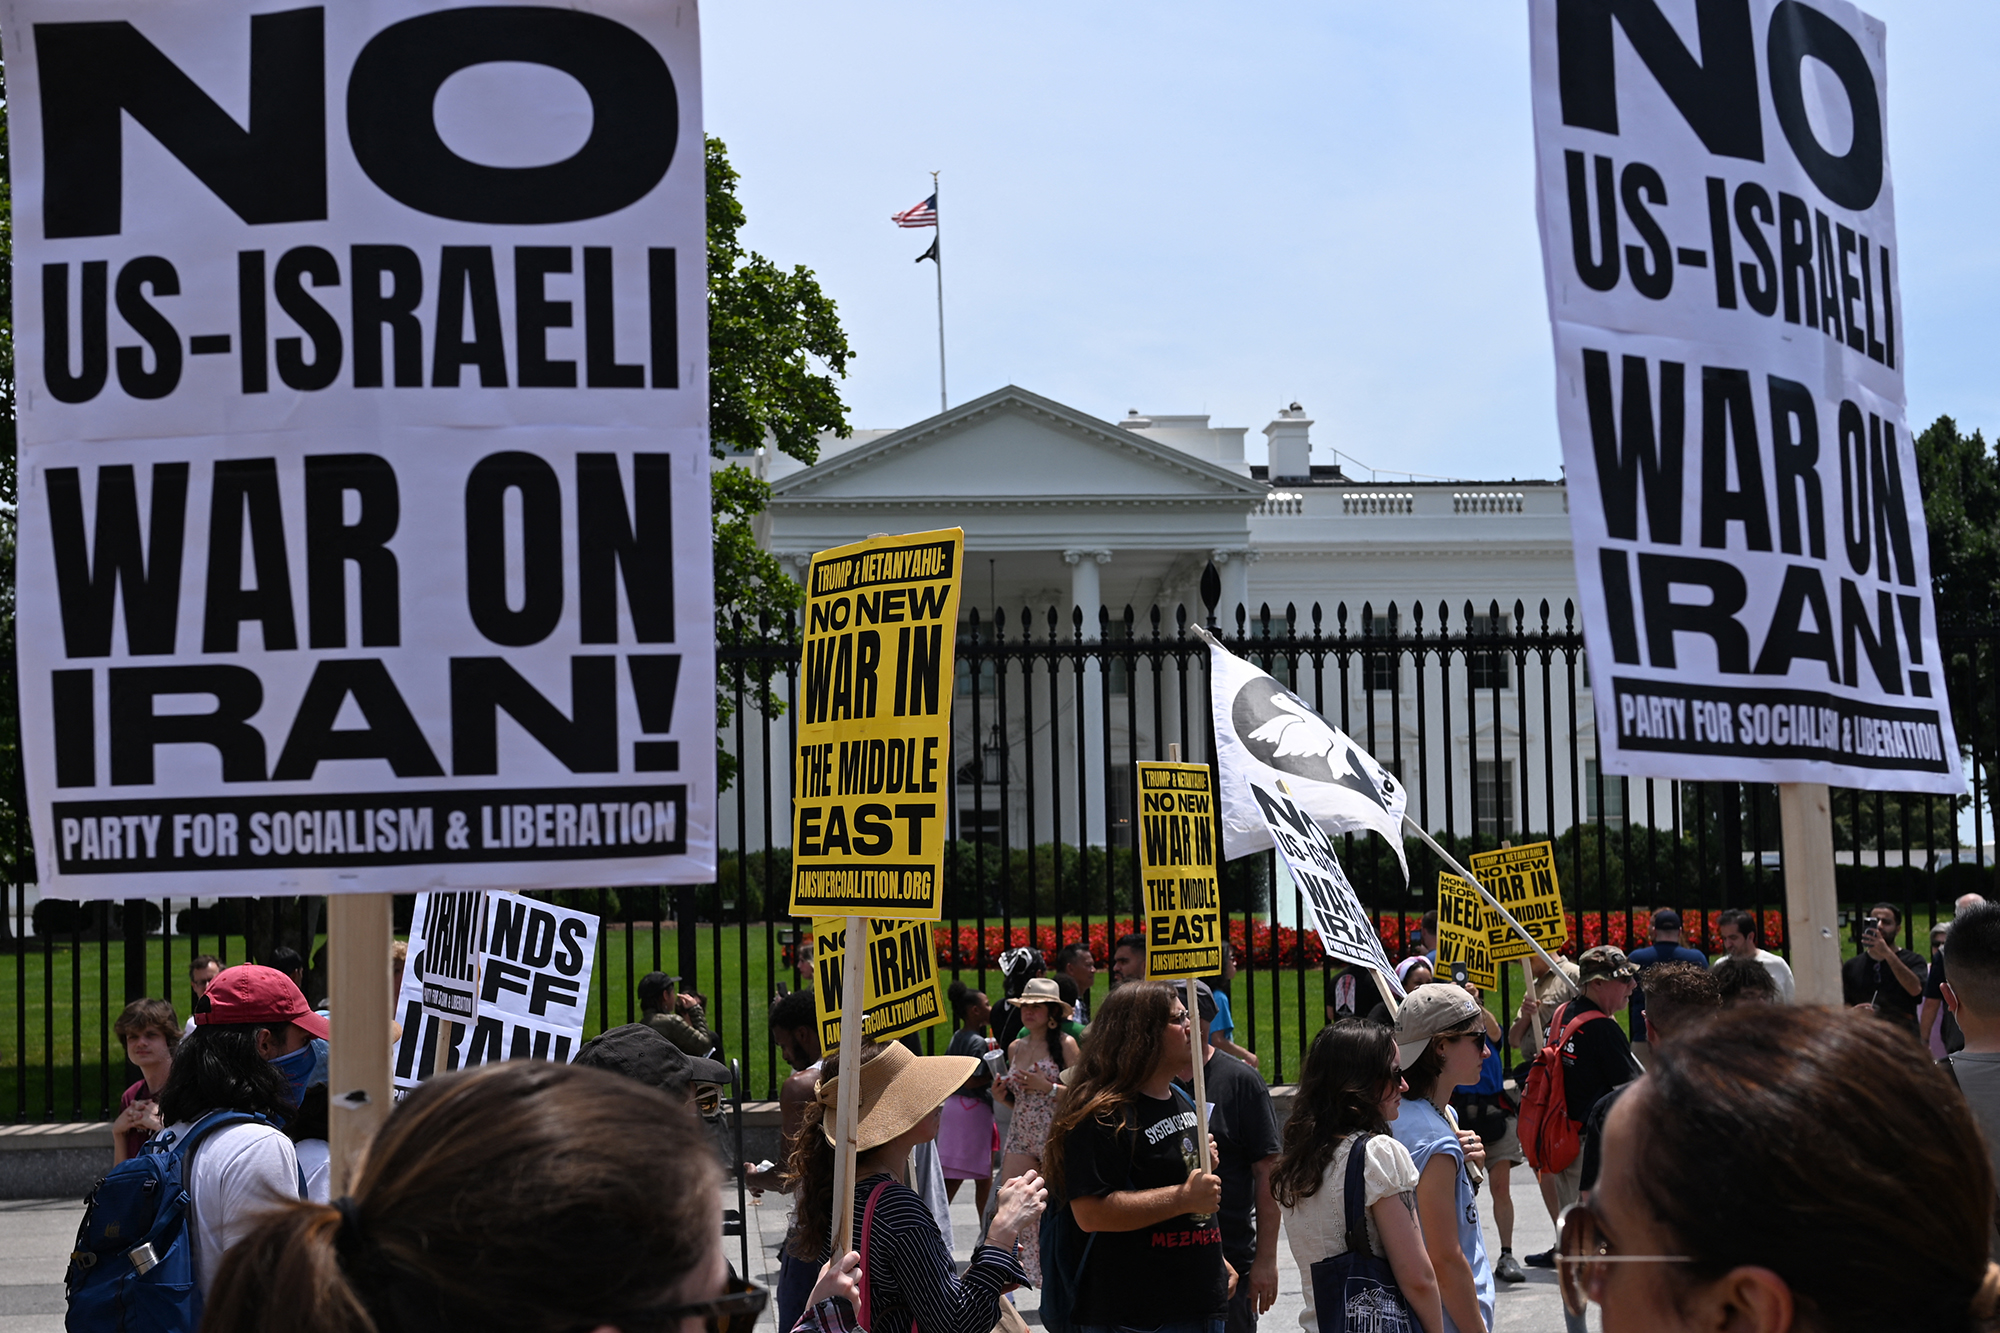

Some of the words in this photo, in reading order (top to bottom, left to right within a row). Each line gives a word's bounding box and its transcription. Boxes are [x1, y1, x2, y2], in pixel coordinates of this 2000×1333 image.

[33, 5, 680, 240] NO
[1556, 0, 1883, 211] NO
[1564, 148, 1895, 370] US-ISRAELI
[42, 244, 680, 404] US-ISRAELI
[1582, 347, 1827, 560] WAR
[1838, 398, 1916, 588] ON
[44, 453, 401, 658] WAR
[465, 450, 675, 647] ON
[817, 560, 852, 593] TRUMP
[853, 560, 861, 585] &
[861, 547, 946, 583] NETANYAHU:
[810, 597, 851, 635] NO
[855, 584, 951, 627] NEW
[1599, 547, 1933, 698] IRAN!
[806, 630, 881, 724] WAR
[893, 624, 943, 716] IN
[51, 654, 682, 788] IRAN!
[1620, 694, 1687, 740] PARTY
[1692, 700, 1734, 743] FOR
[1738, 703, 1839, 750] SOCIALISM
[1842, 717, 1852, 753] &
[1854, 715, 1942, 761] LIBERATION
[801, 743, 833, 798] THE
[838, 737, 938, 795] MIDDLE
[1145, 771, 1170, 787] TRUMP
[1172, 773, 1177, 787] &
[1144, 793, 1174, 812] NO
[1178, 793, 1209, 813] NEW
[1250, 783, 1337, 865] NO
[62, 815, 163, 860] PARTY
[173, 811, 239, 858] FOR
[249, 807, 434, 856] SOCIALISM
[445, 811, 470, 850] &
[481, 801, 676, 849] LIBERATION
[798, 803, 936, 856] EAST
[1144, 815, 1190, 866] WAR
[1195, 816, 1211, 866] IN
[1476, 855, 1498, 867] TRUMP
[1505, 848, 1545, 862] NETANYAHU:
[1476, 867, 1502, 880] NO
[1506, 858, 1549, 874] NEW
[798, 870, 931, 900] ANSWERCOALITION.ORG
[1147, 878, 1175, 911] THE
[1180, 878, 1216, 910] MIDDLE
[1441, 876, 1474, 891] MONE
[1530, 869, 1554, 898] IN
[1151, 914, 1216, 946] EAST
[1440, 893, 1483, 932] NEED
[1488, 919, 1561, 945] EAST
[1508, 900, 1559, 923] MIDDLE
[869, 922, 931, 999] IRAN
[1152, 950, 1218, 971] ANSWERCOALITION.ORG
[1440, 929, 1465, 942] NOT
[1467, 937, 1486, 949] WA
[1144, 1117, 1178, 1145] SYSTEM
